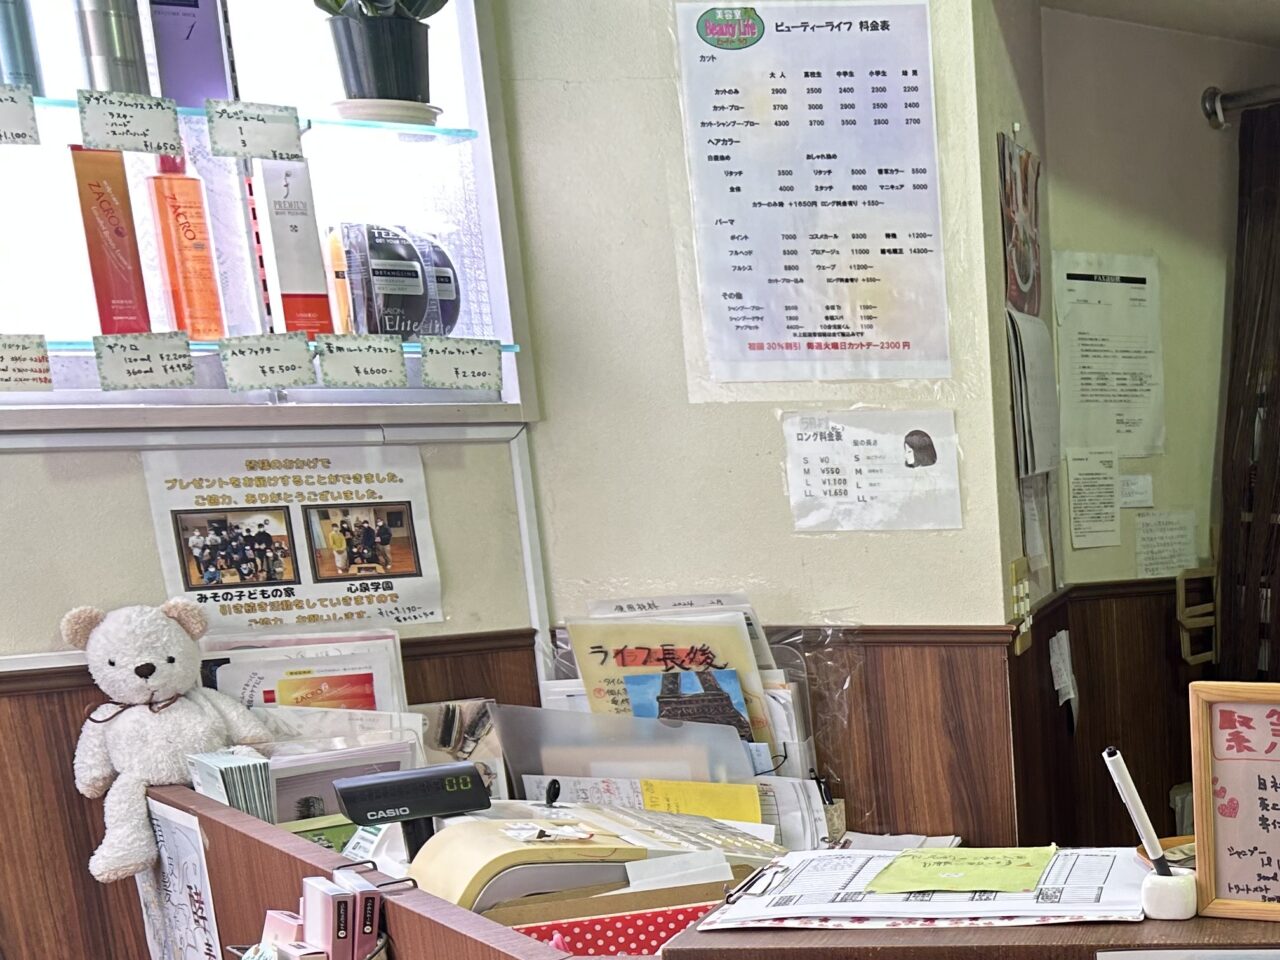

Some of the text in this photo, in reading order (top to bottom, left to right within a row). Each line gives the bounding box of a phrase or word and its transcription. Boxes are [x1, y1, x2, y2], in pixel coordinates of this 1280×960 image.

[775, 20, 891, 33] ビューティーライフ 料金表
[699, 54, 717, 63] カット
[722, 291, 743, 300] その他
[384, 315, 420, 333] Elite
[245, 457, 331, 472] 皆様のおかげで
[854, 454, 860, 462] S
[164, 473, 405, 491] プレゼントをお届けすることができました。
[804, 490, 815, 498] LL
[857, 495, 867, 503] LL
[196, 586, 296, 604] みその子どもの家
[589, 643, 728, 673] ライフ長後
[367, 806, 410, 821] CASIO
